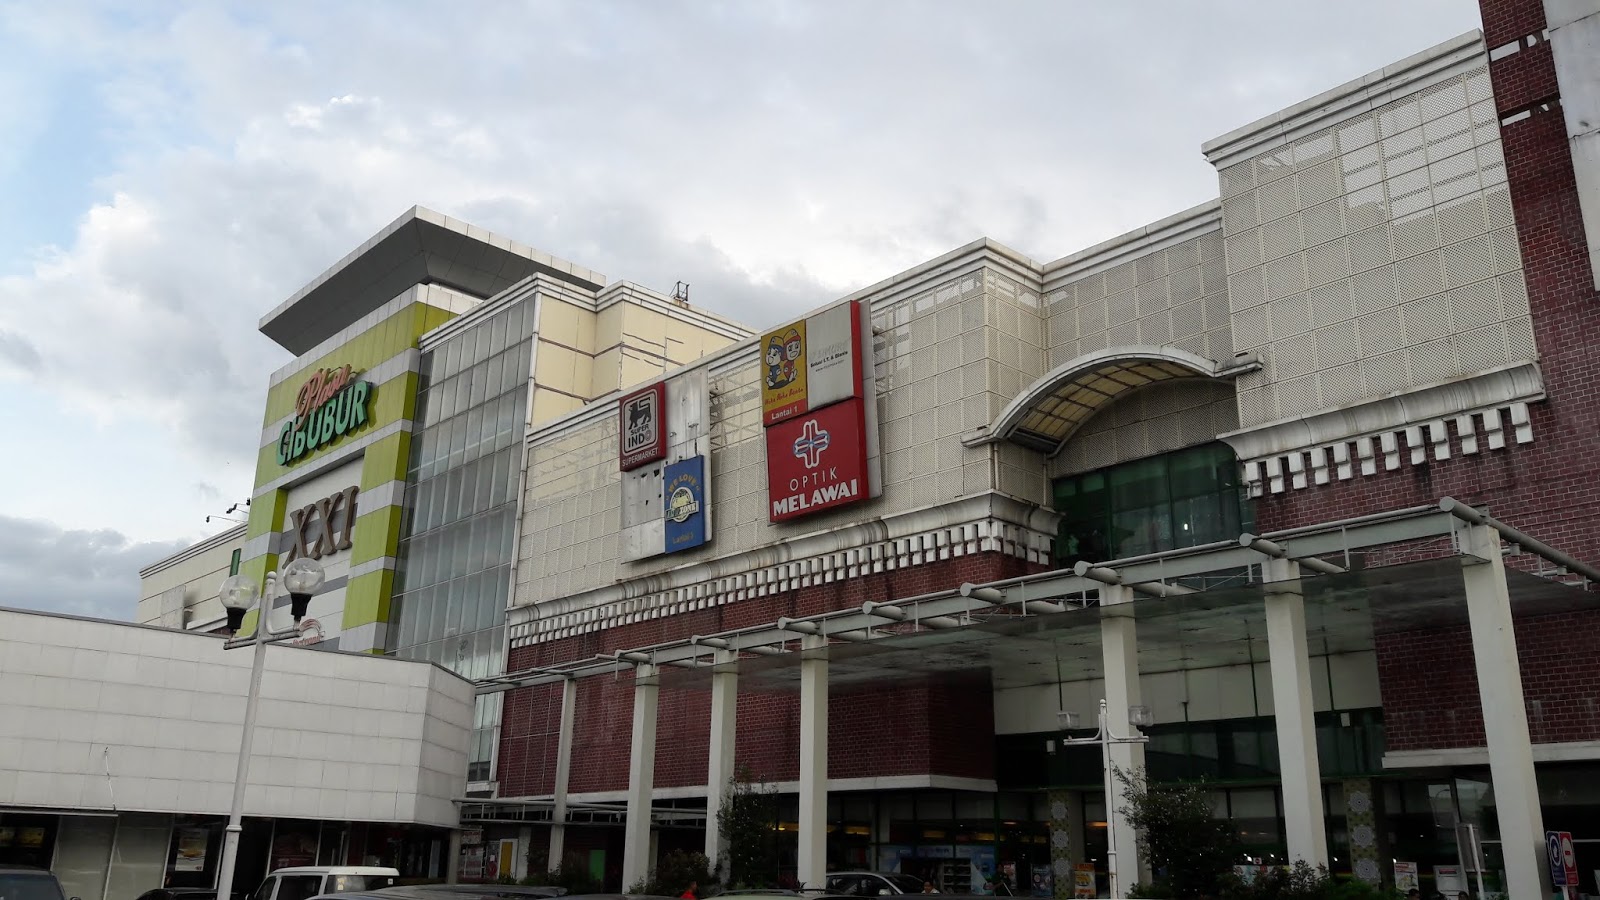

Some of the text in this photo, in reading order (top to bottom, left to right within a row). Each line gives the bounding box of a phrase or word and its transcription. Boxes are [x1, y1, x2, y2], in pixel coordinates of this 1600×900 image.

[276, 380, 370, 466] CIBUBUR
[771, 405, 798, 420] Lantai 1
[628, 429, 652, 448] INDO
[630, 423, 650, 436] SUPER
[621, 446, 659, 468] SUPERMARKET
[678, 473, 697, 486] LOVE
[789, 466, 838, 492] OPTIK
[773, 478, 858, 517] MELAWAI
[282, 485, 360, 569] XXI
